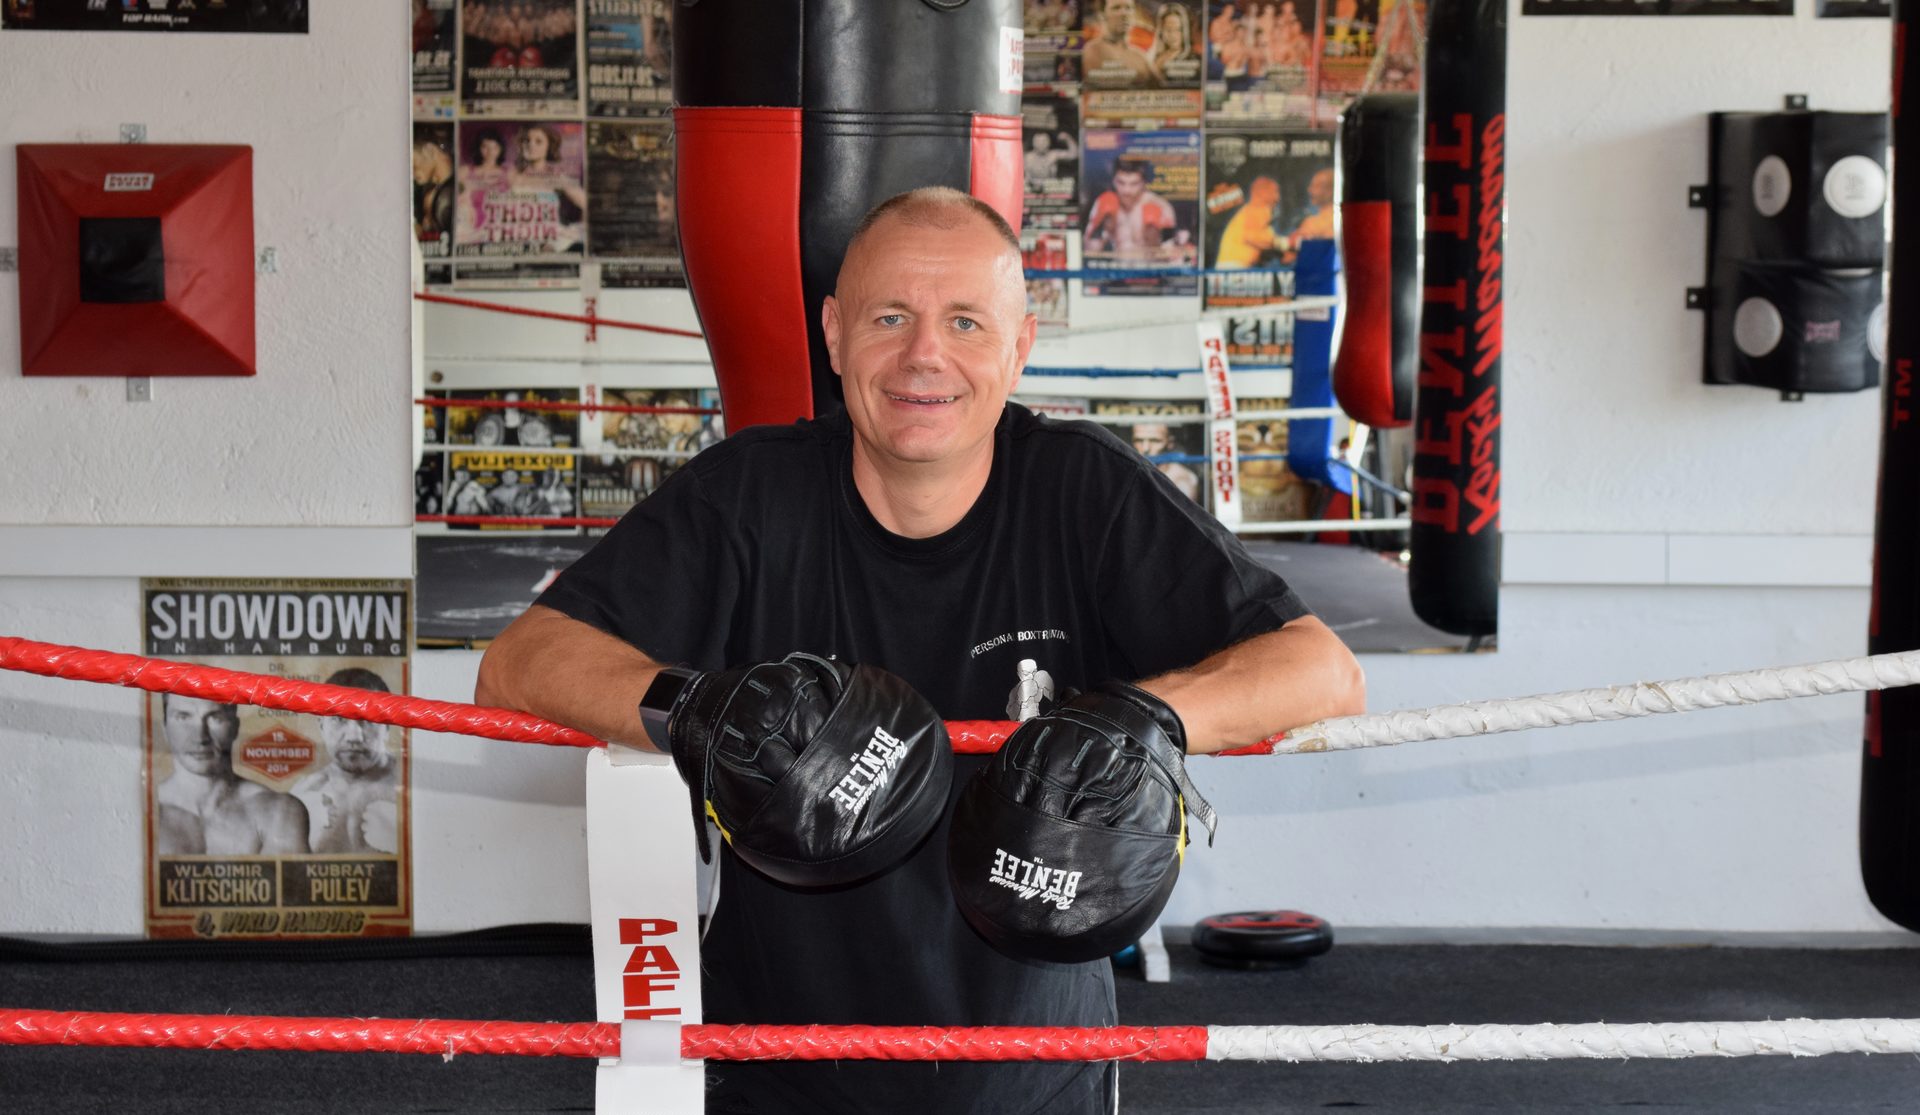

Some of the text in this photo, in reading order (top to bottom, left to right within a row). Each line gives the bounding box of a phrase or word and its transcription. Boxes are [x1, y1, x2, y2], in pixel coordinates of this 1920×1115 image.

[151, 594, 401, 641] SHOWDOWN
[152, 642, 401, 655] IN HAMBURG
[970, 632, 1014, 659] PERSONA
[269, 662, 287, 672] DR.
[246, 748, 310, 758] NOVEMBER
[266, 764, 290, 774] 2014
[828, 726, 900, 811] BENLEE
[1033, 856, 1044, 864] TM
[175, 863, 262, 877] WLADIMIR
[306, 863, 376, 877] KUBRAT
[990, 847, 1083, 899] BENLEE
[166, 879, 271, 903] KLITSCHKO
[311, 879, 371, 902] PULEV
[220, 912, 280, 933] WORLD
[282, 911, 366, 933] HAMBURG
